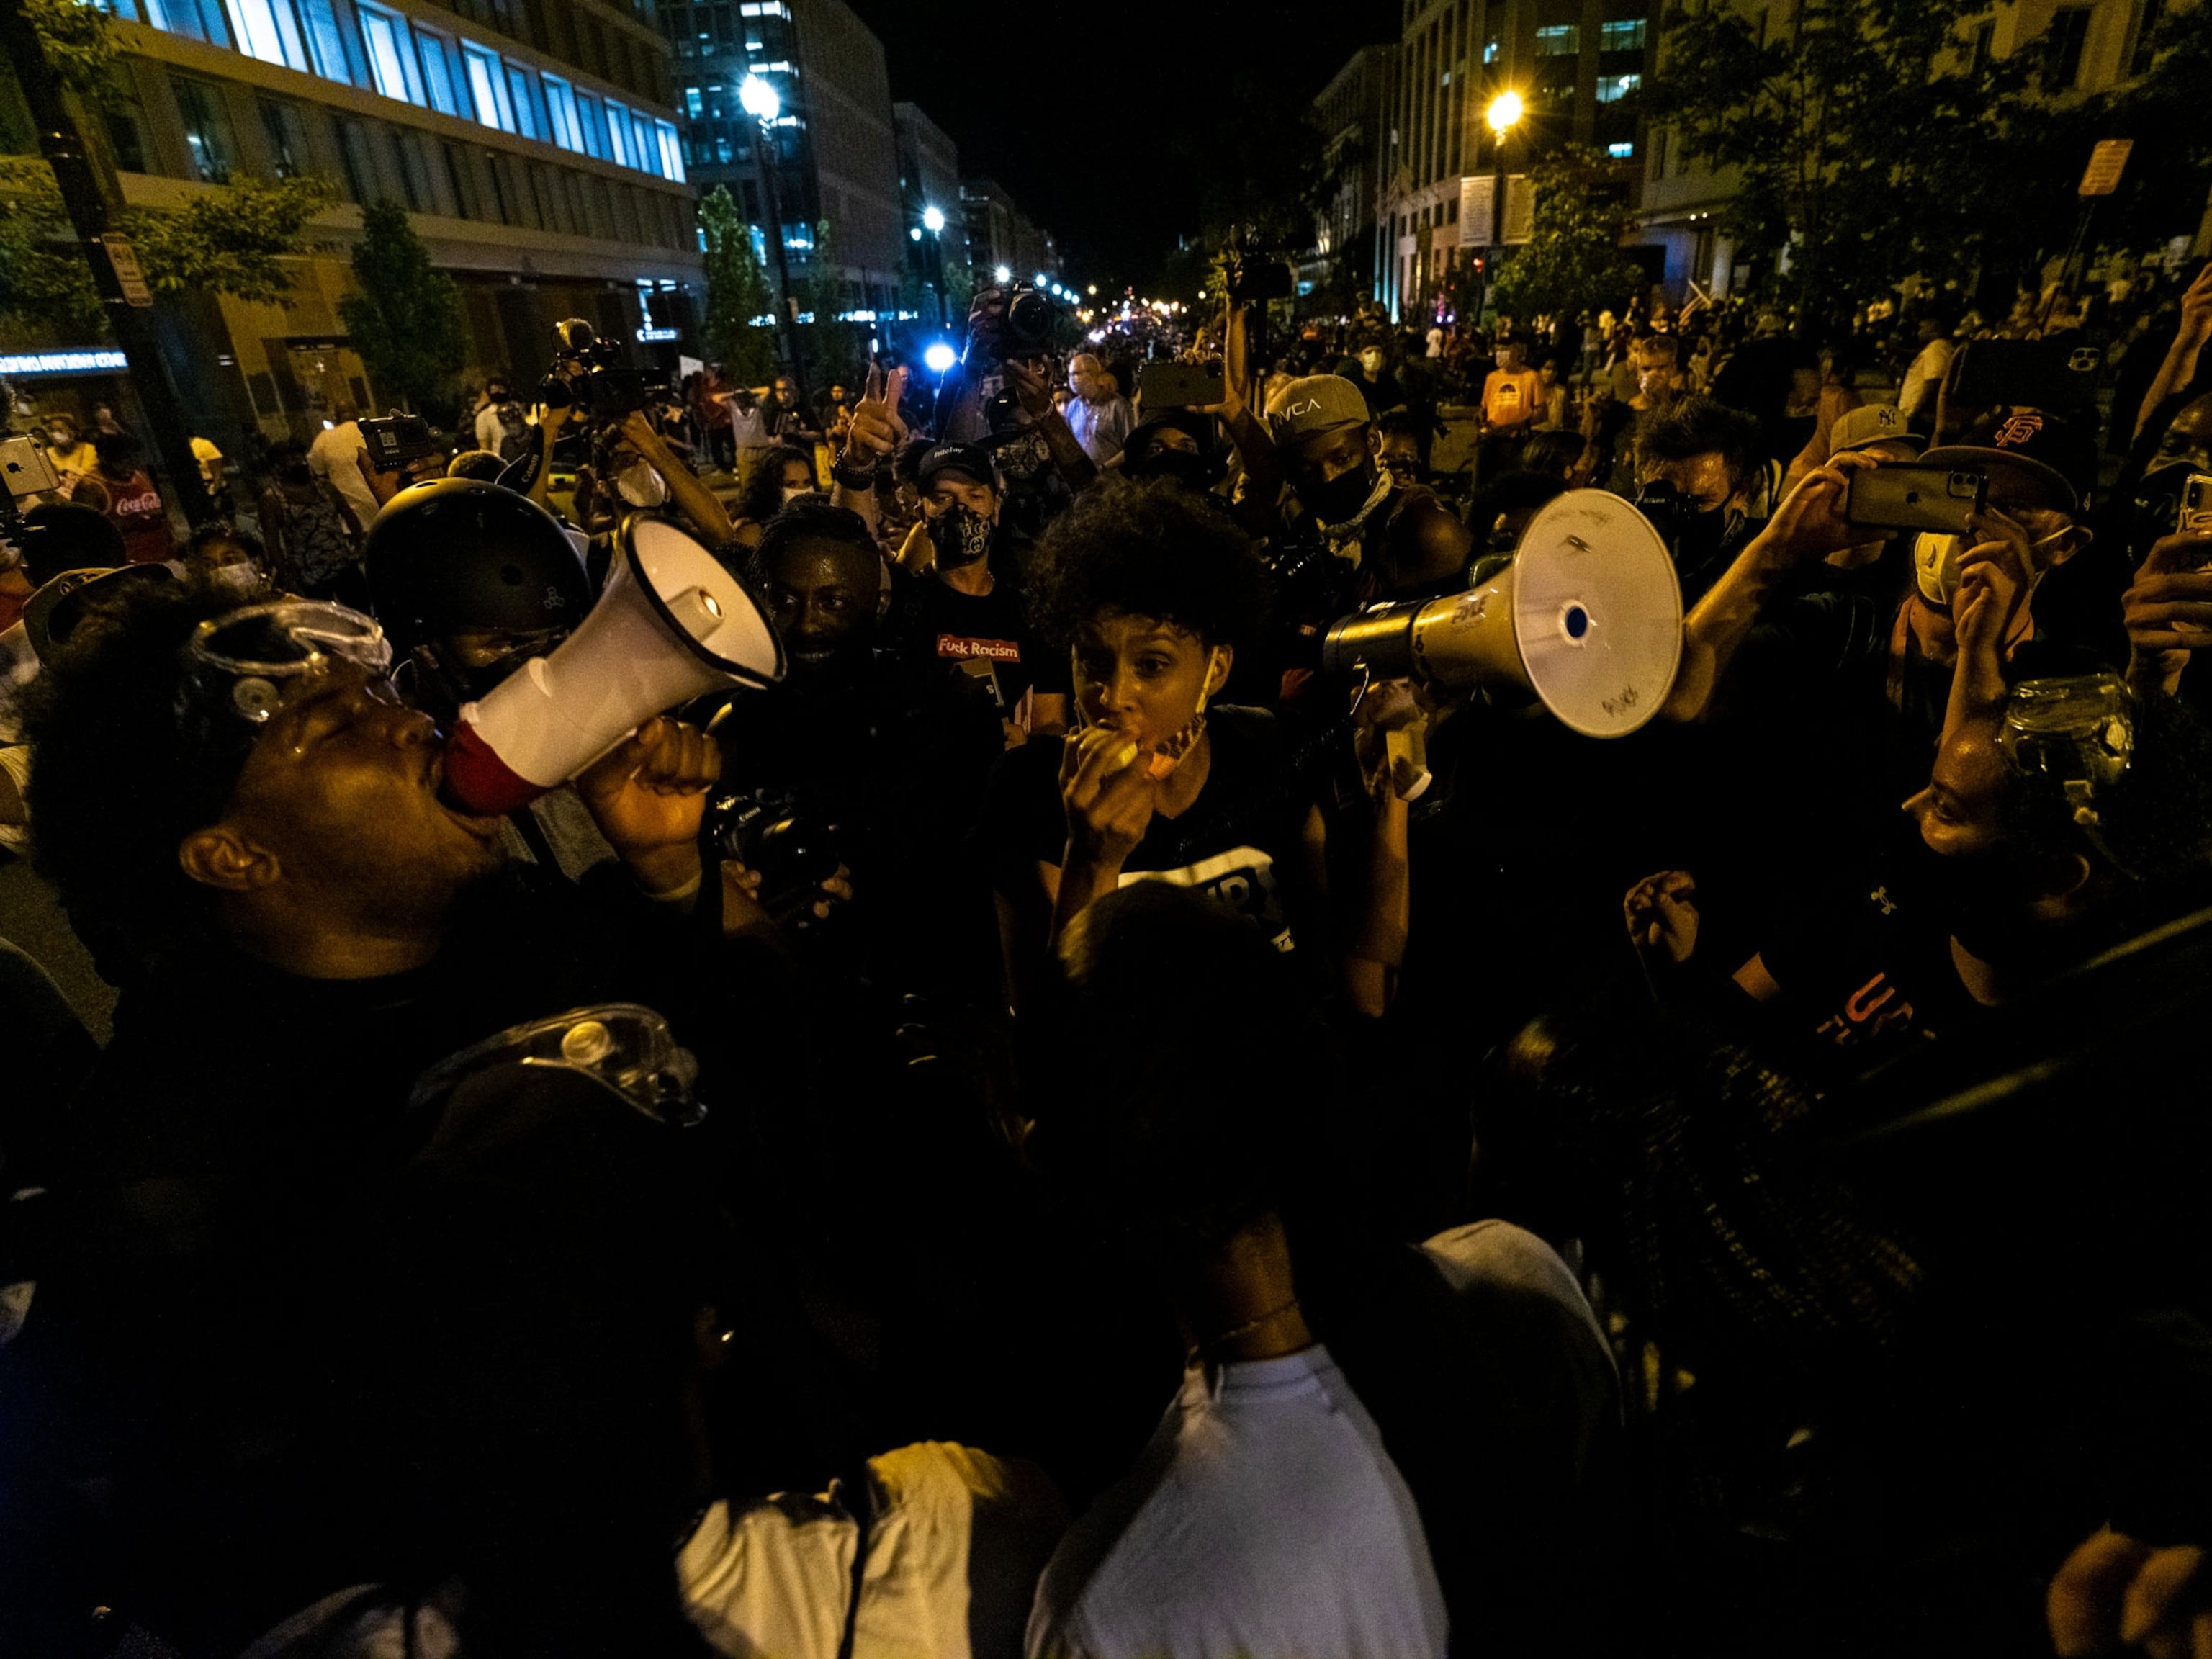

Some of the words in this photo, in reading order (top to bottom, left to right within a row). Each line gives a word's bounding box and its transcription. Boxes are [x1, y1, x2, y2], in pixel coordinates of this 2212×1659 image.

[521, 454, 539, 483] Canon
[938, 638, 969, 655] Fuck
[971, 641, 1018, 657] Racism
